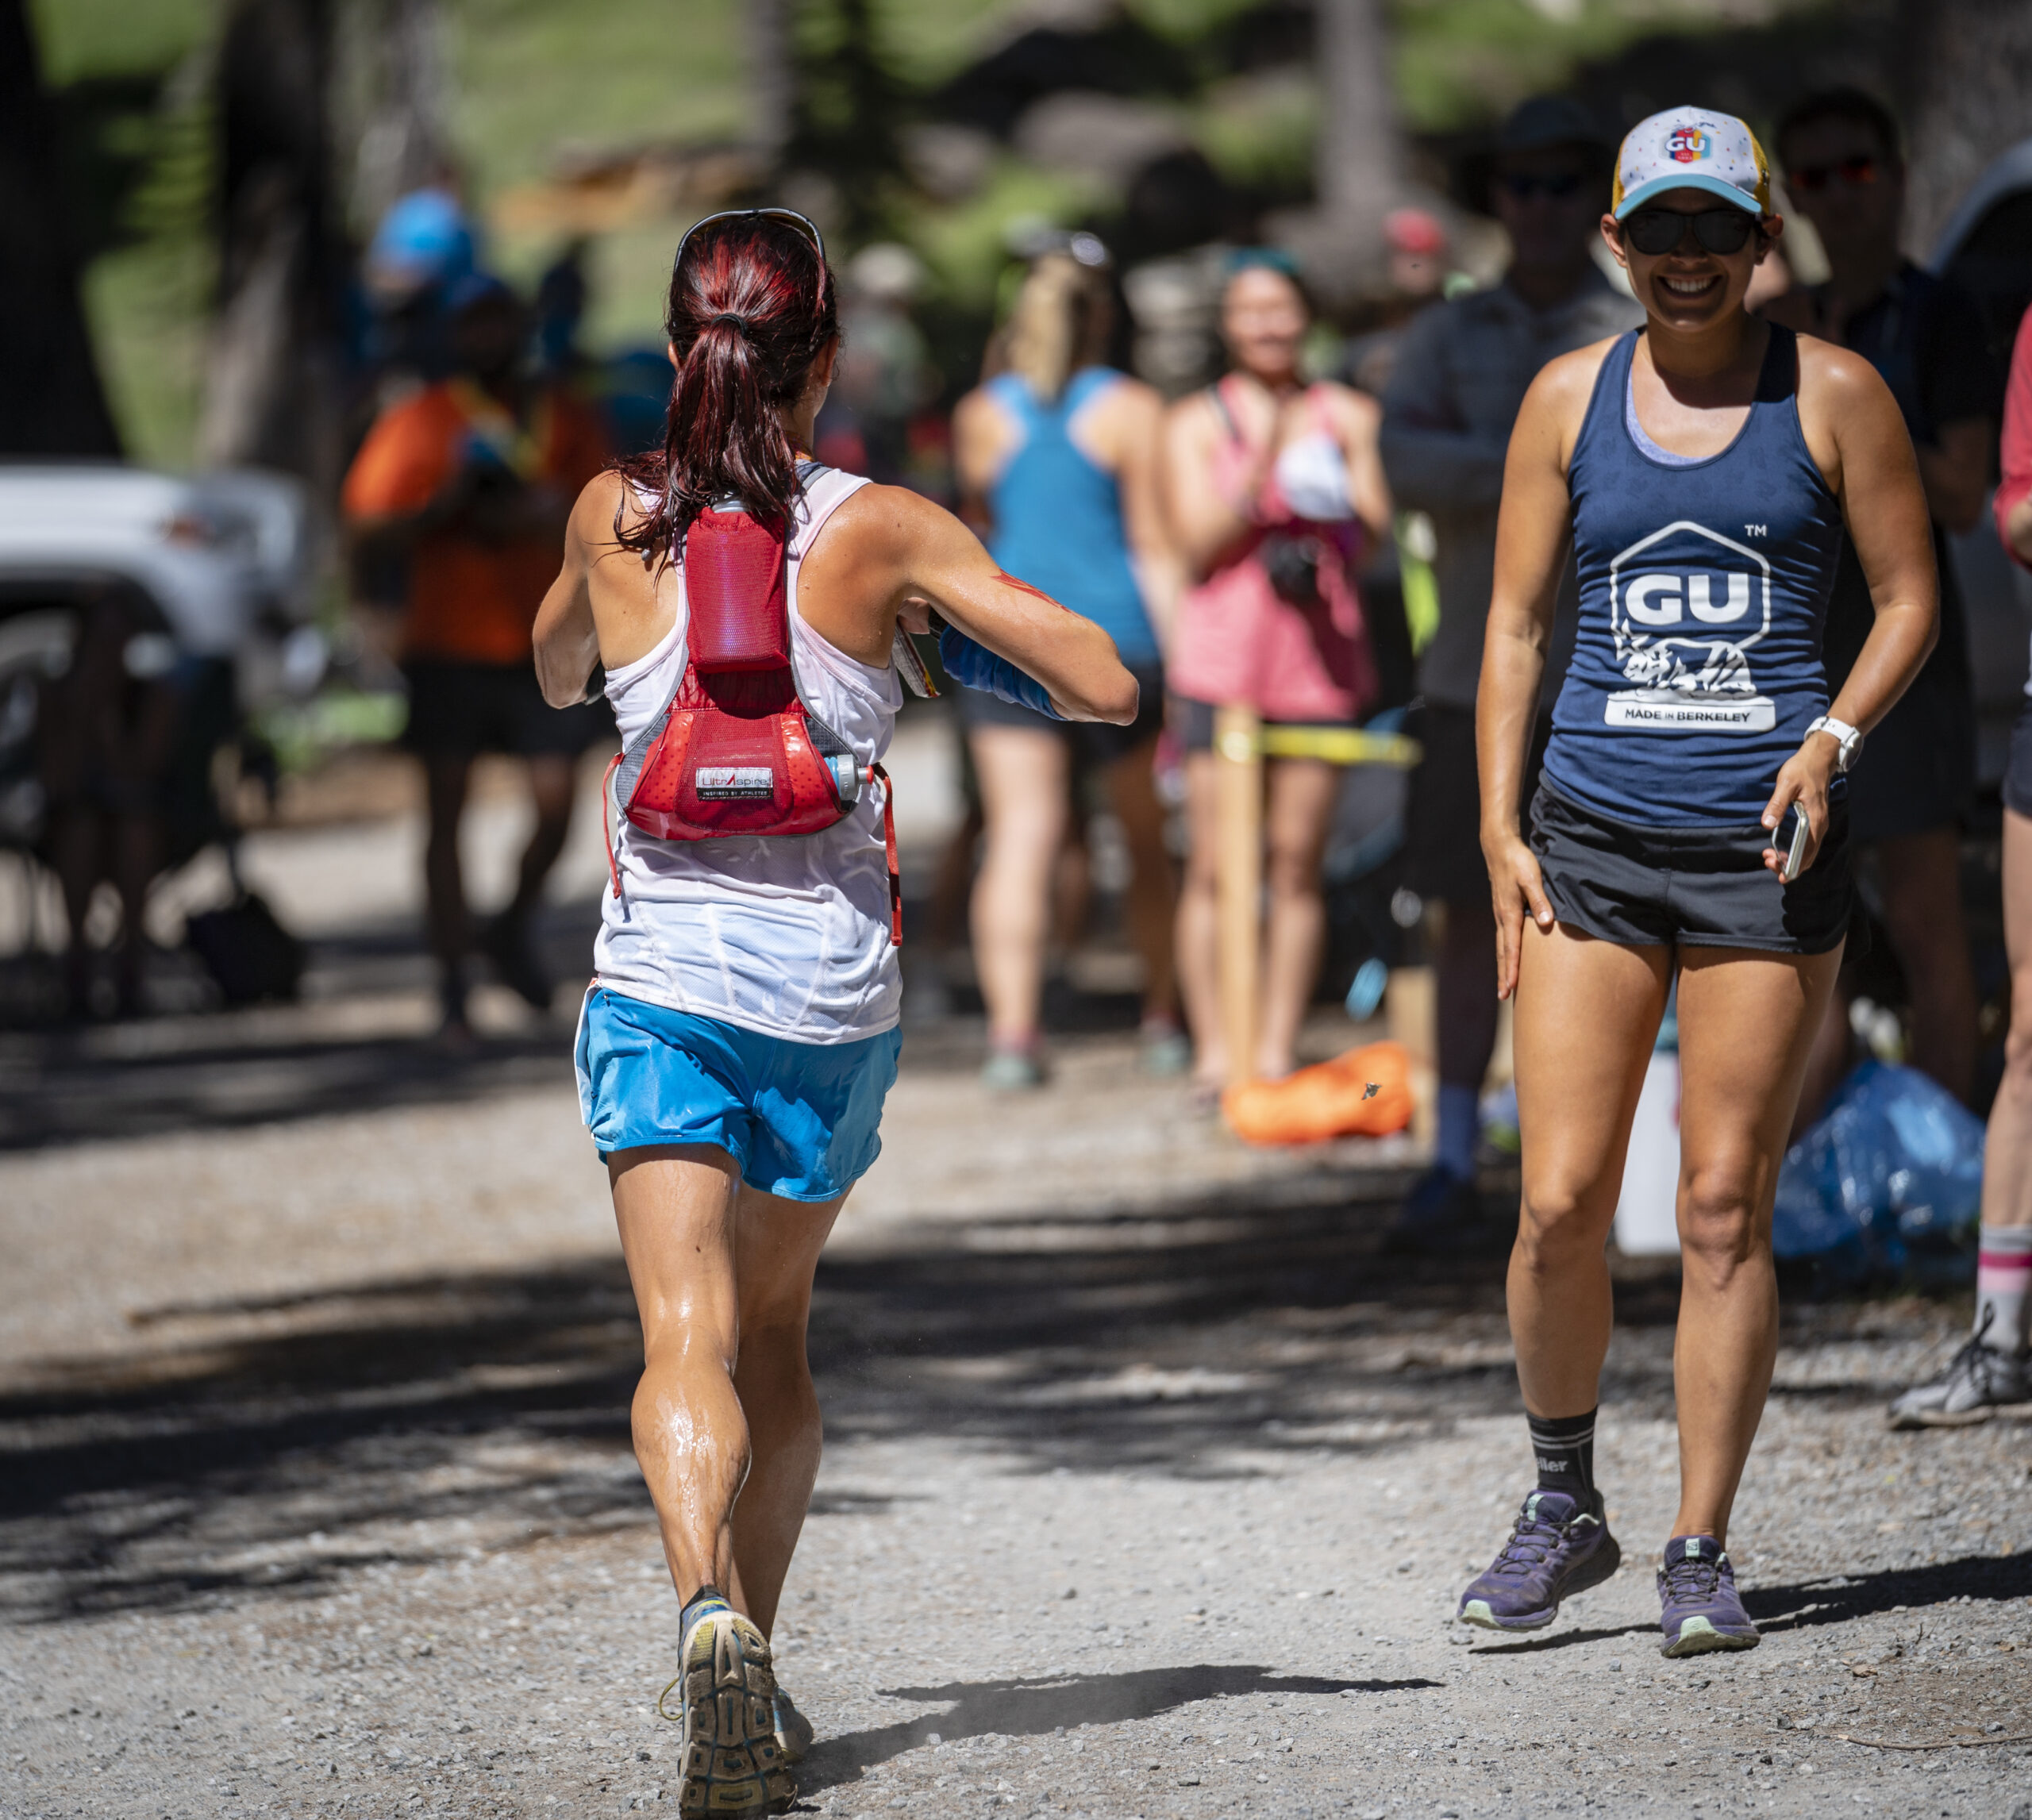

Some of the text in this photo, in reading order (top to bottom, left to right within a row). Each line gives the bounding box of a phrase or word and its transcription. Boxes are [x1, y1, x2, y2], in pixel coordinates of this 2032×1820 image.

[1665, 137, 1706, 152] GU
[1625, 572, 1749, 626] GU
[1625, 709, 1751, 722] MADE IN BERKELEY
